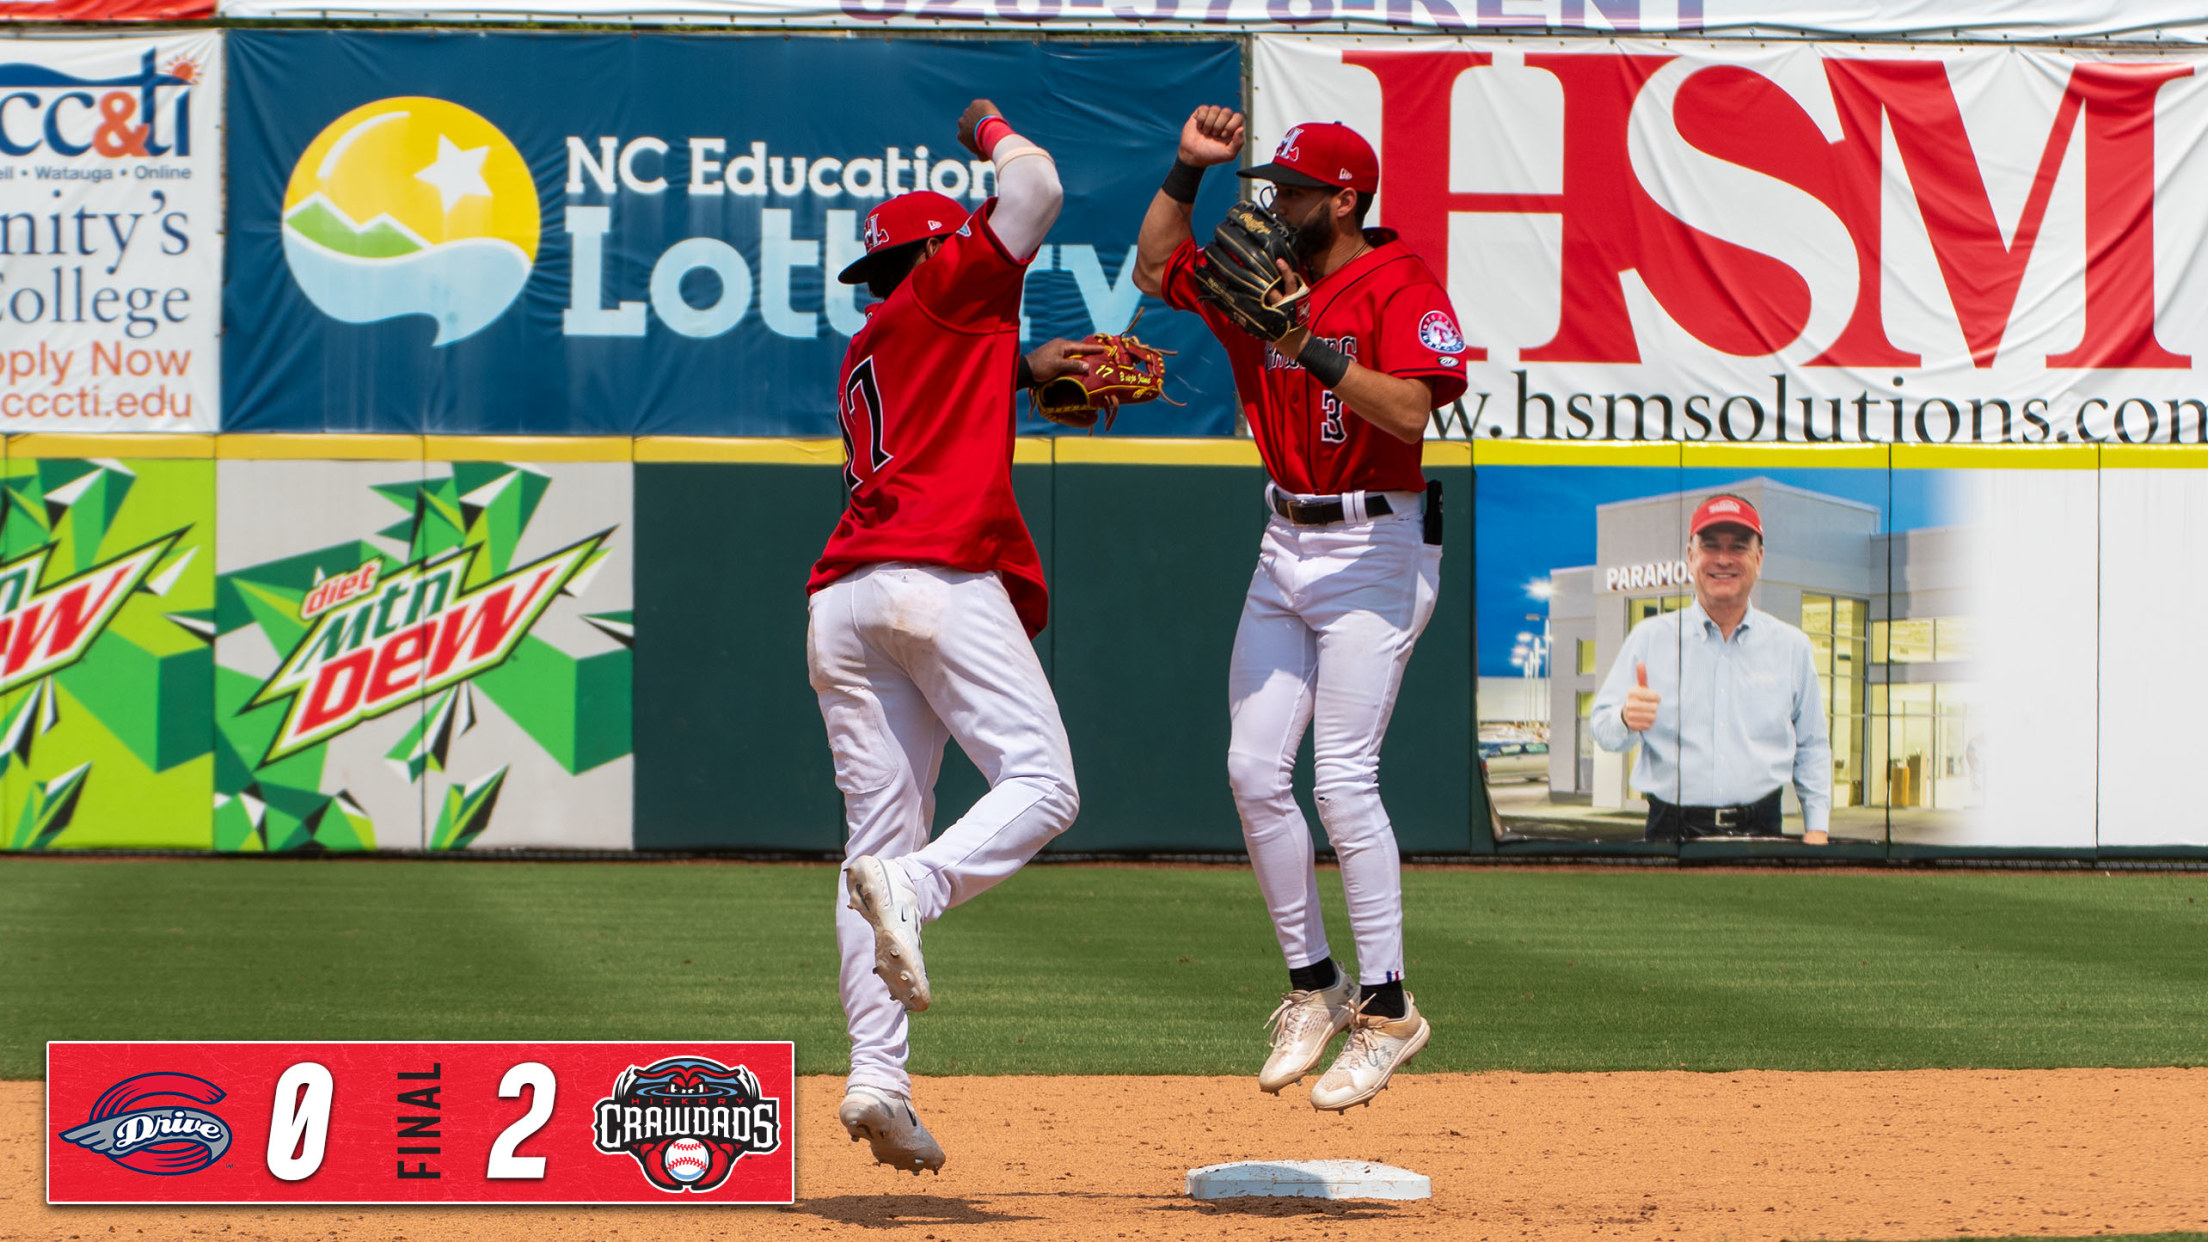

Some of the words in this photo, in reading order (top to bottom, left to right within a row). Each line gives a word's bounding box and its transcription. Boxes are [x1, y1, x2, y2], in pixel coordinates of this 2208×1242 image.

[34, 166, 113, 183] Watauga
[134, 165, 192, 180] Online
[565, 137, 669, 195] NC
[687, 138, 999, 199] Education
[1342, 50, 2194, 369] HSM
[0, 266, 190, 339] ollege
[0, 341, 75, 387] ply
[91, 341, 192, 377] Now
[1321, 390, 1347, 443] 3
[305, 565, 375, 616] diet
[1606, 561, 1695, 592] PARAMO
